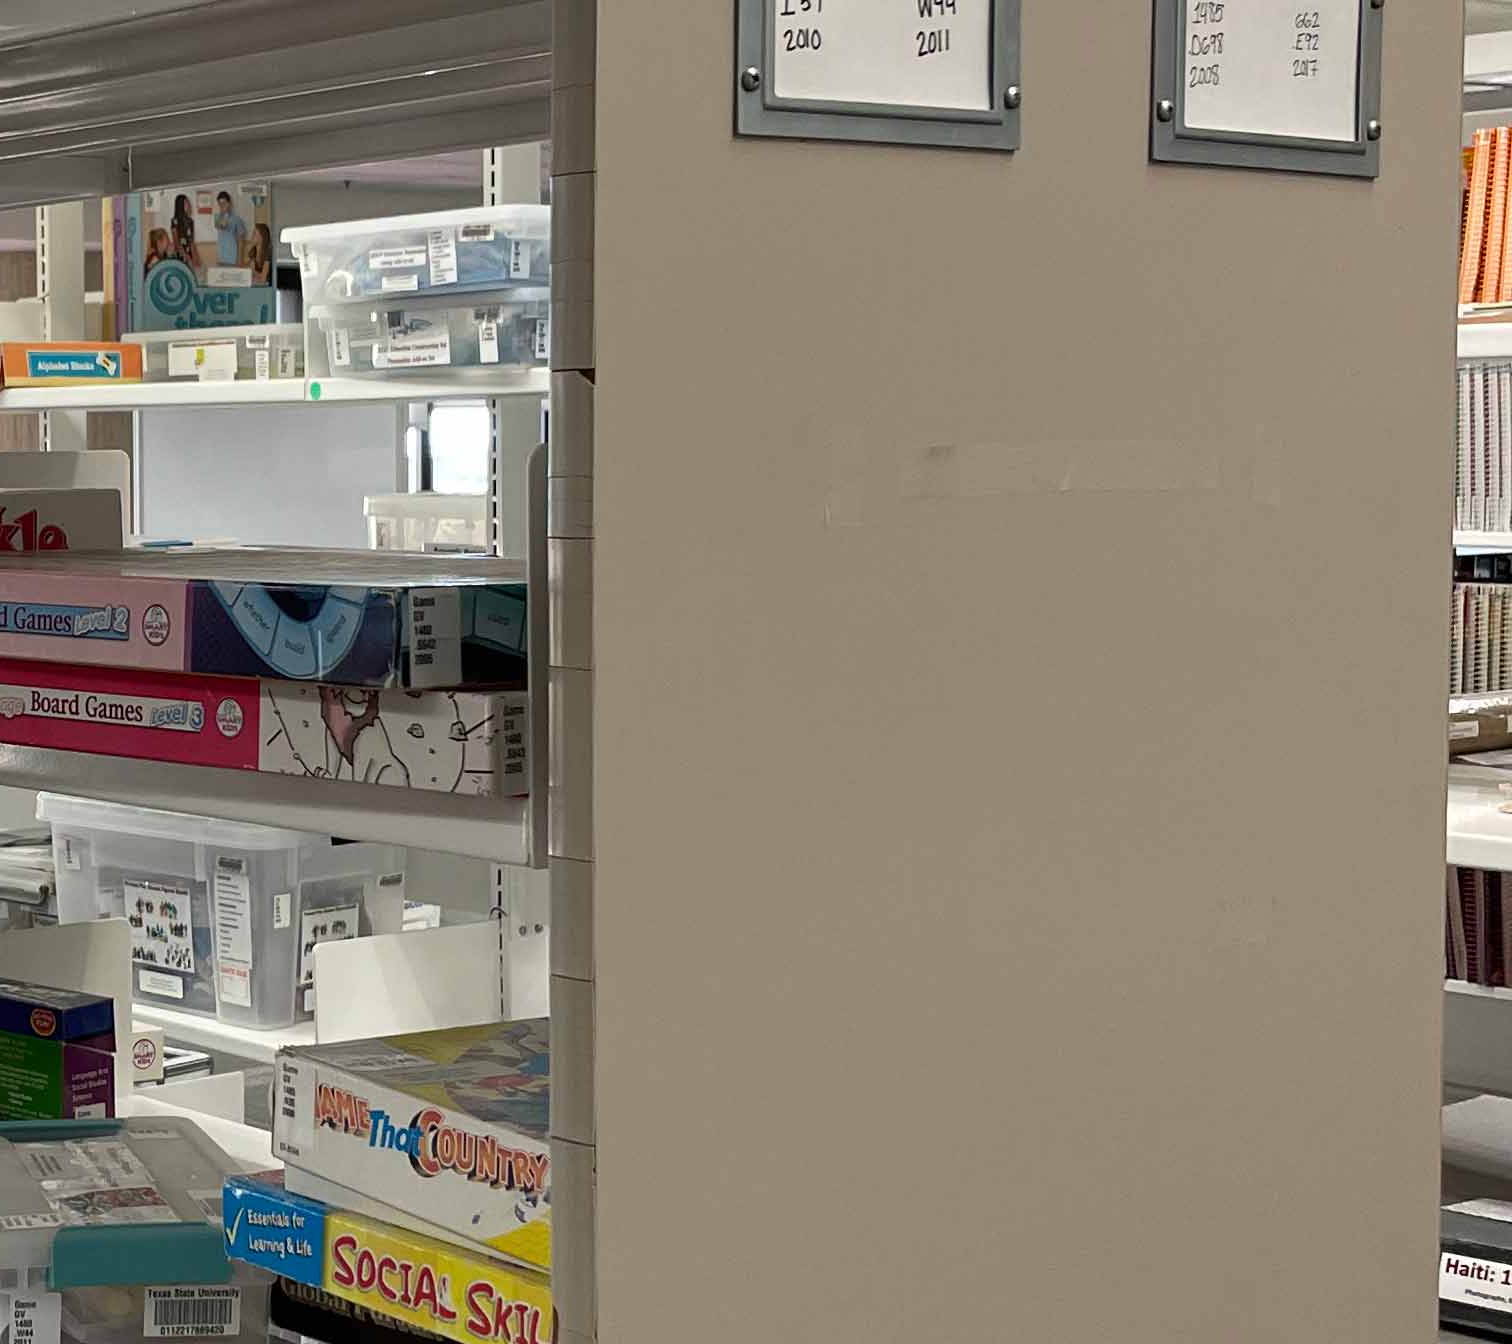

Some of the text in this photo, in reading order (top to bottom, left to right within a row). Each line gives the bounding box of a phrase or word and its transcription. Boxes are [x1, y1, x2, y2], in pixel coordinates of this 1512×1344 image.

[1191, 1, 1225, 25] 1485
[782, 26, 951, 57] 2010 2011
[1189, 64, 1220, 88] 2008
[13, 604, 72, 635] Games
[73, 606, 113, 636] Level
[112, 605, 129, 633] 2
[31, 690, 80, 719] Board
[84, 694, 145, 724] Games
[150, 703, 189, 727] Level
[190, 702, 205, 729] 3
[367, 1110, 425, 1154] That
[410, 1106, 551, 1201] COUNTRY
[247, 1208, 306, 1230] Essentials for
[248, 1236, 313, 1260] Learning & Life
[332, 1235, 458, 1323] SOCIAL
[1444, 1257, 1496, 1283] Haiti:
[13, 1300, 37, 1310] Game
[148, 1288, 240, 1301] Texas State University
[14, 1311, 26, 1320] GV
